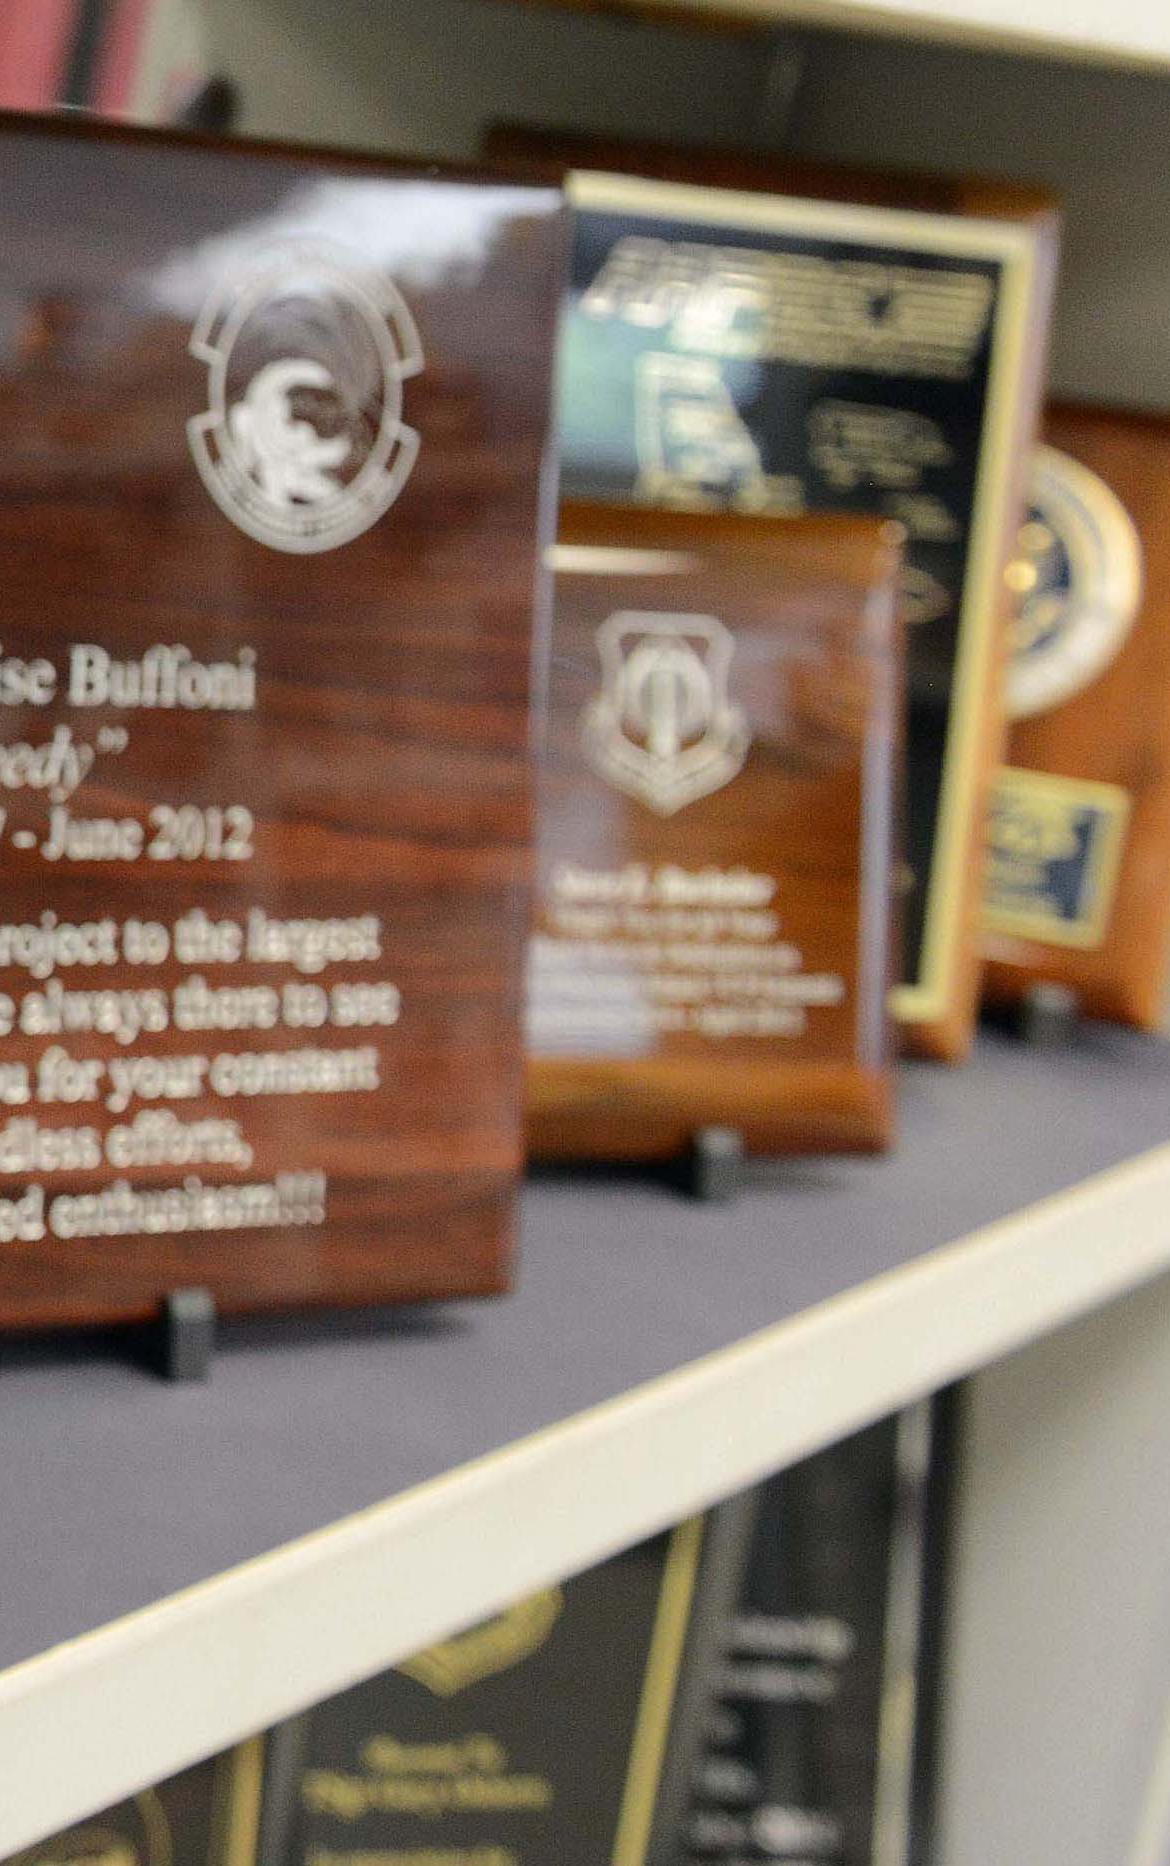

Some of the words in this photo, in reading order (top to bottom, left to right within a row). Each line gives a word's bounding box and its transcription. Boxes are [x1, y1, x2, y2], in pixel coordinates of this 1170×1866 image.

[40, 805, 145, 862] June
[147, 804, 255, 862] 2012
[122, 921, 171, 966] to
[173, 905, 243, 965] the
[36, 1045, 106, 1103] for
